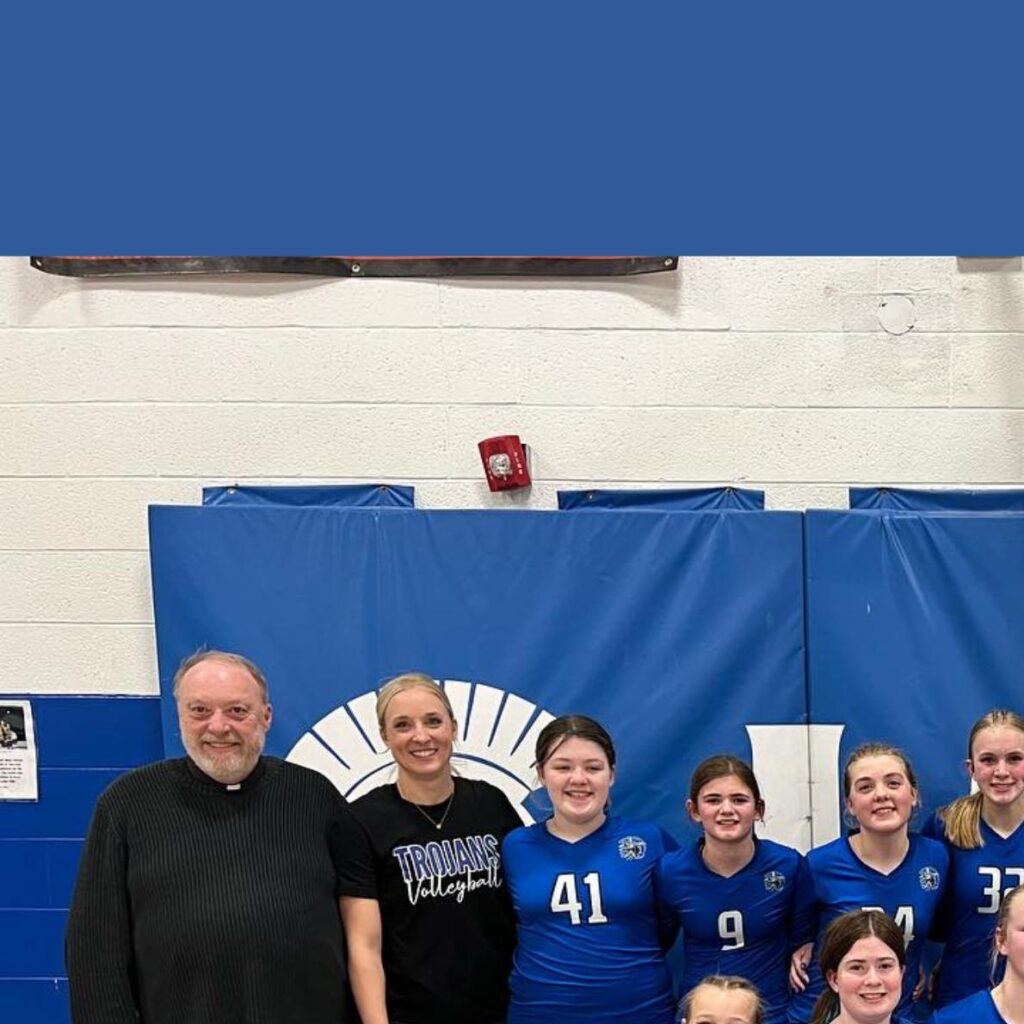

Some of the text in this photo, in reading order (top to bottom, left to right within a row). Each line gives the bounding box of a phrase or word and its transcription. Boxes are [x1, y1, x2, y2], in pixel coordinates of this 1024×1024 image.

[392, 833, 501, 884] TROJANS
[406, 857, 503, 906] Volleyball
[550, 872, 608, 925] 41
[717, 910, 745, 951] 9
